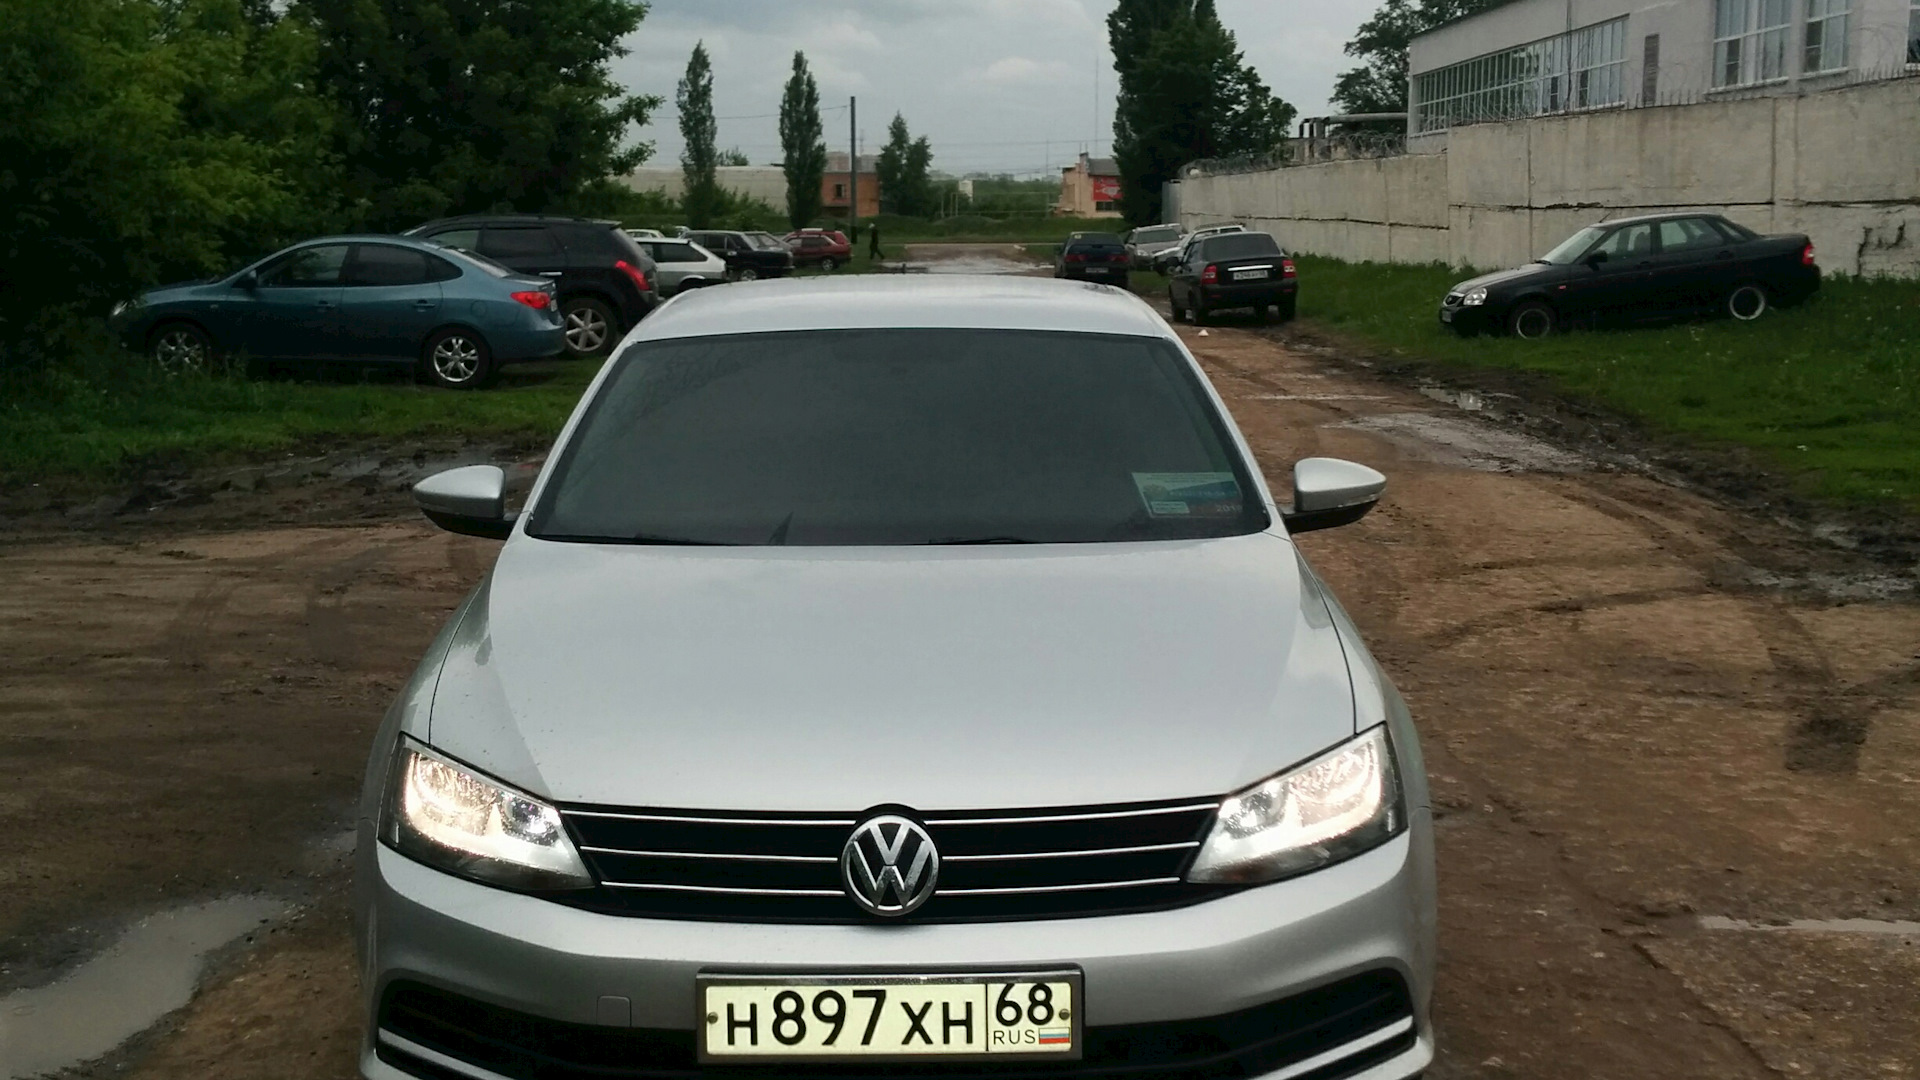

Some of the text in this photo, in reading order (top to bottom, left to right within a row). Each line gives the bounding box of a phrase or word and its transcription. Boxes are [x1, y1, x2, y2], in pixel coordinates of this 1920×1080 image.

[845, 818, 935, 911] VW
[995, 983, 1054, 1027] 68
[993, 1030, 1036, 1045] RUS
